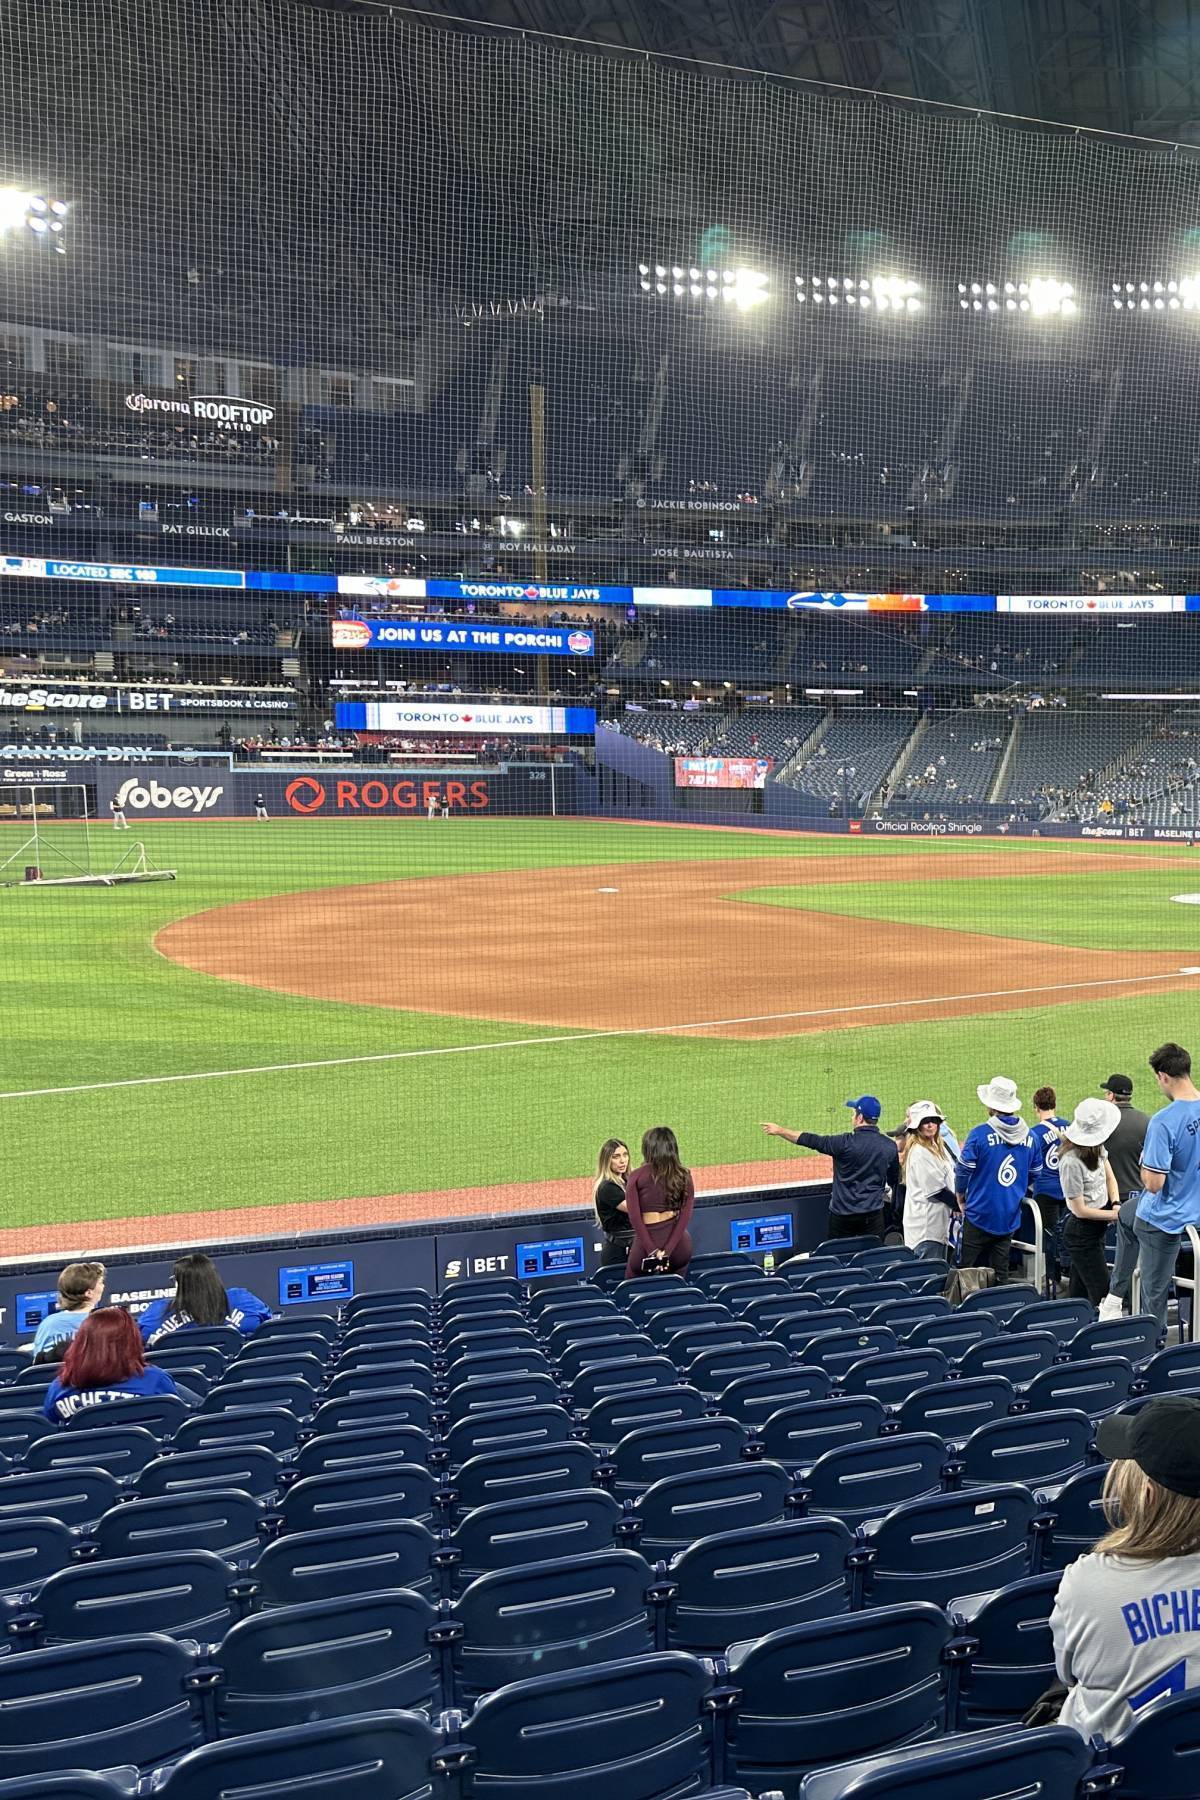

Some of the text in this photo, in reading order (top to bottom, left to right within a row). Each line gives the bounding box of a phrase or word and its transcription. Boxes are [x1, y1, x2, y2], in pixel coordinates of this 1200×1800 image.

[125, 393, 274, 425] Corona ROOFTOP
[217, 420, 252, 432] PATIO
[651, 500, 740, 511] JACKIE ROBINSON
[4, 512, 54, 525] GASTON
[162, 524, 230, 537] PAT GILLICK
[336, 534, 414, 546] PAUL BEESTON
[499, 542, 576, 554] ROY HALLADAY
[684, 549, 734, 559] BAUTISTA
[53, 564, 108, 578] LOCATED
[460, 584, 600, 600] TORONTO BLUE JAYS
[1027, 599, 1084, 609] TORONTO
[1127, 600, 1155, 609] JAYS
[377, 627, 416, 642] JOIN
[421, 629, 443, 643] US
[449, 629, 468, 643] AT
[470, 630, 500, 645] THE
[130, 692, 174, 711] BET
[180, 697, 244, 709] SPORTSBOOK
[245, 699, 252, 709] &
[253, 699, 289, 710] CASINO
[396, 711, 460, 724] TORONTO
[505, 714, 534, 725] JAYS
[0, 744, 102, 761] CANADA
[528, 771, 546, 780] 328
[118, 777, 224, 813] Sobeys
[336, 780, 490, 809] ROGERS
[875, 821, 909, 832] Official
[911, 821, 947, 833] Roofing
[948, 822, 983, 834] Shingle
[1128, 828, 1145, 837] BET
[1153, 829, 1194, 839] BASELINE
[1045, 1143, 1061, 1171] 6
[997, 1153, 1018, 1188] 6
[474, 1255, 509, 1274] BET
[110, 1287, 177, 1304] BASELINE
[130, 1301, 152, 1313] BO
